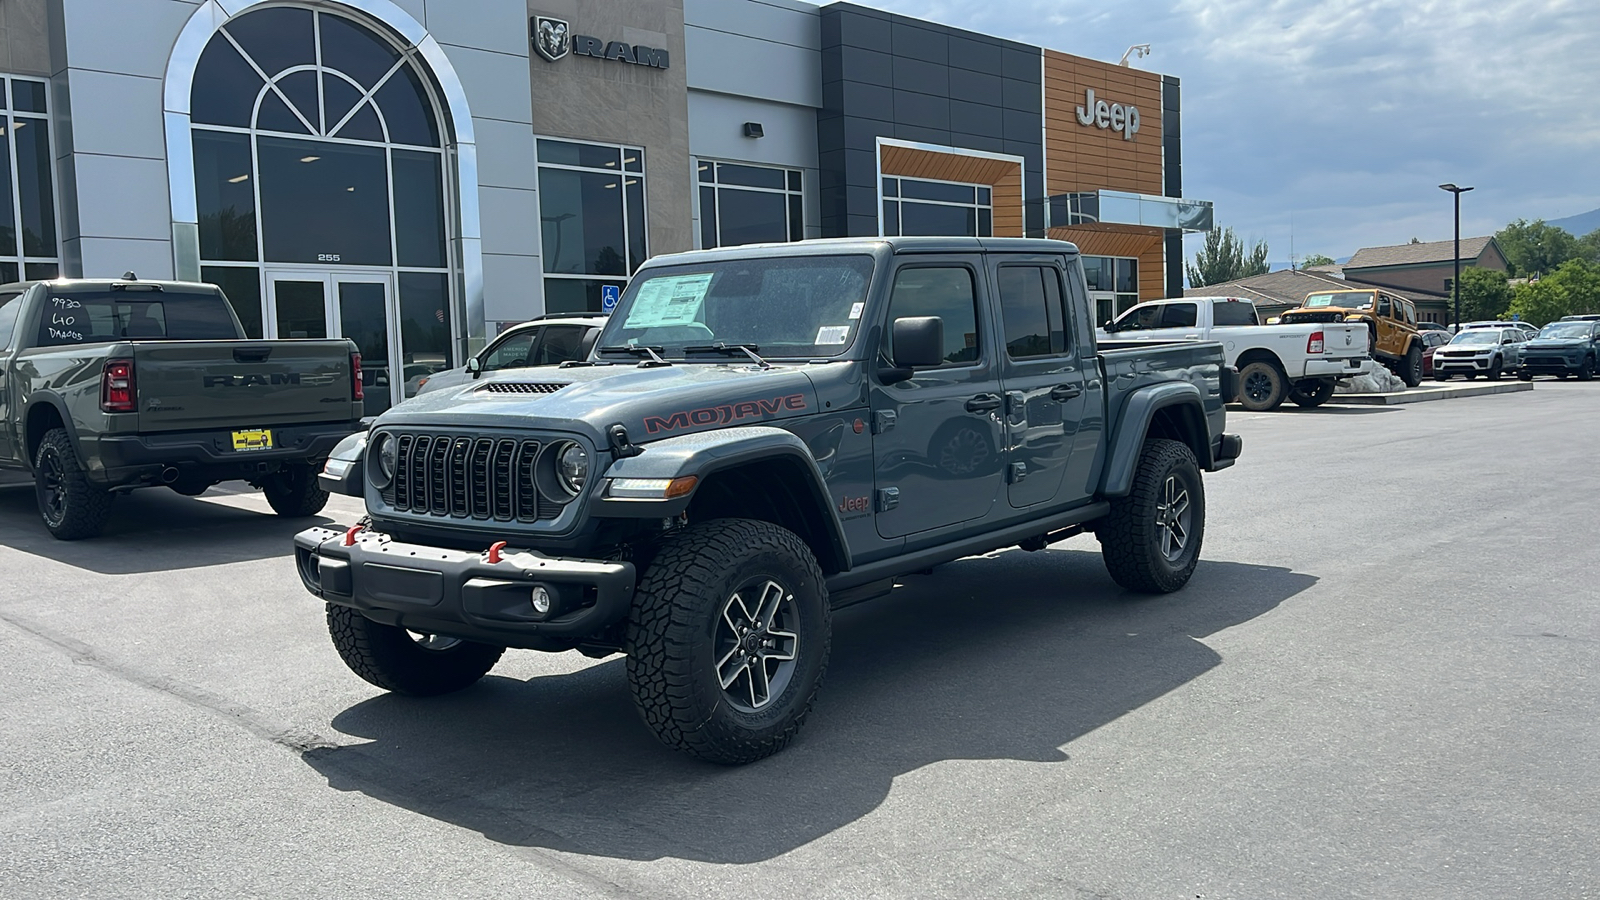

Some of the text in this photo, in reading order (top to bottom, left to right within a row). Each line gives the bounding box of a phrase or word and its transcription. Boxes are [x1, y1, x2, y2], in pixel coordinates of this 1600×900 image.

[572, 34, 670, 69] RAM
[1076, 88, 1140, 140] Jeep
[318, 253, 340, 262] 255
[203, 373, 300, 388] RAM
[643, 394, 807, 434] MOJAVE
[839, 496, 869, 513] Jeep
